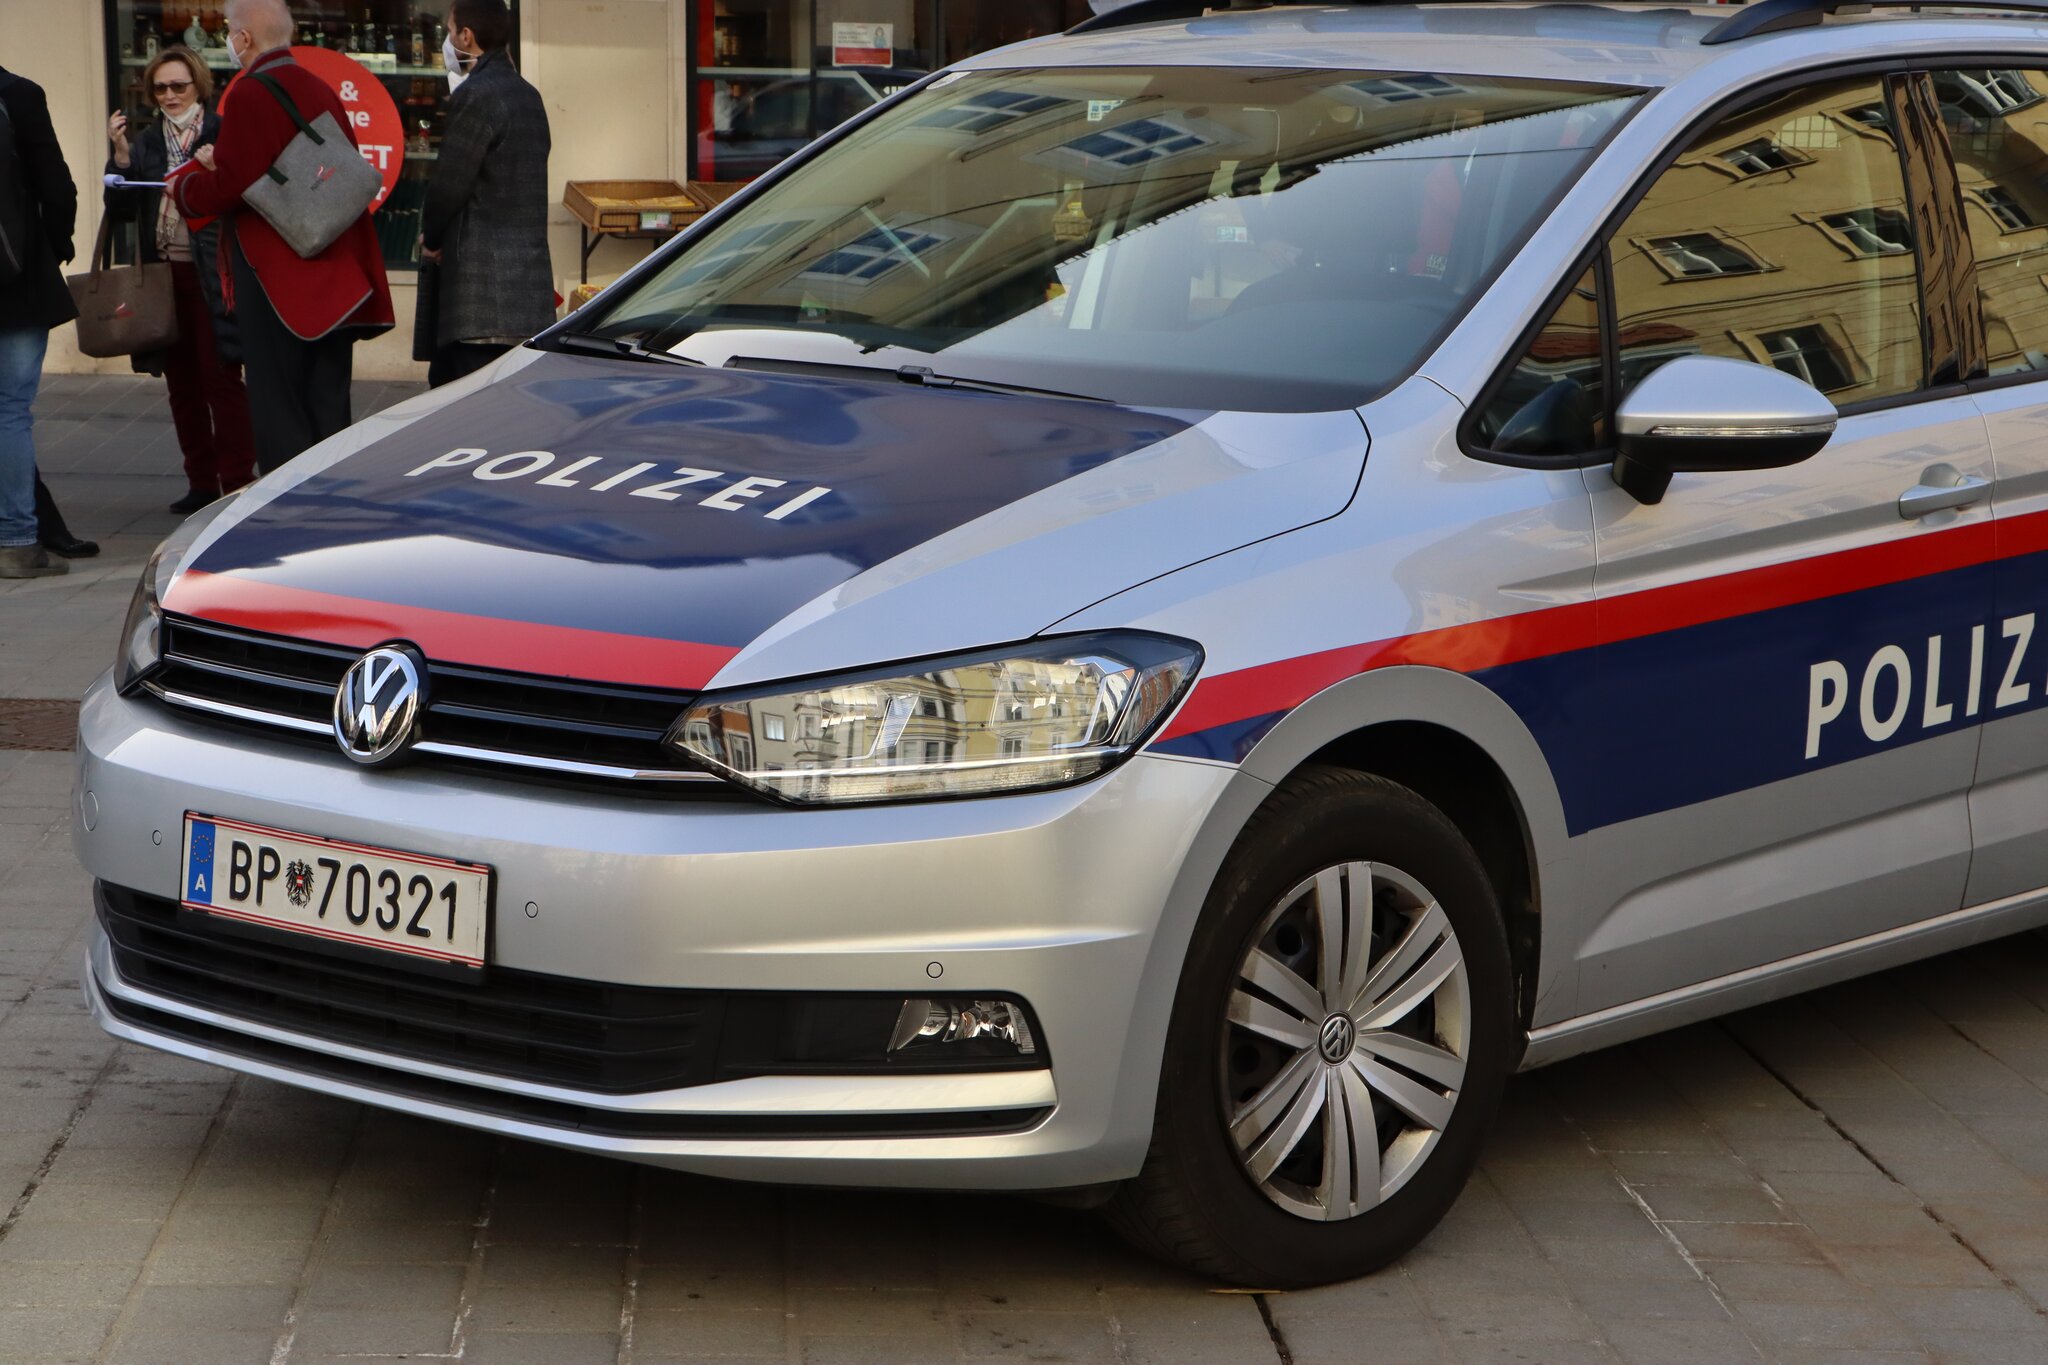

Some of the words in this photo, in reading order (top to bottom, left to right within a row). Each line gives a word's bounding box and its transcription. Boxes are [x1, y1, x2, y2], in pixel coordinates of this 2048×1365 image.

[340, 80, 358, 102] &
[358, 143, 393, 170] ET
[403, 448, 832, 520] POLIZEI
[1805, 612, 2048, 760] POLIZ
[194, 873, 206, 893] A
[229, 839, 281, 907] BP
[317, 856, 458, 944] 70321
